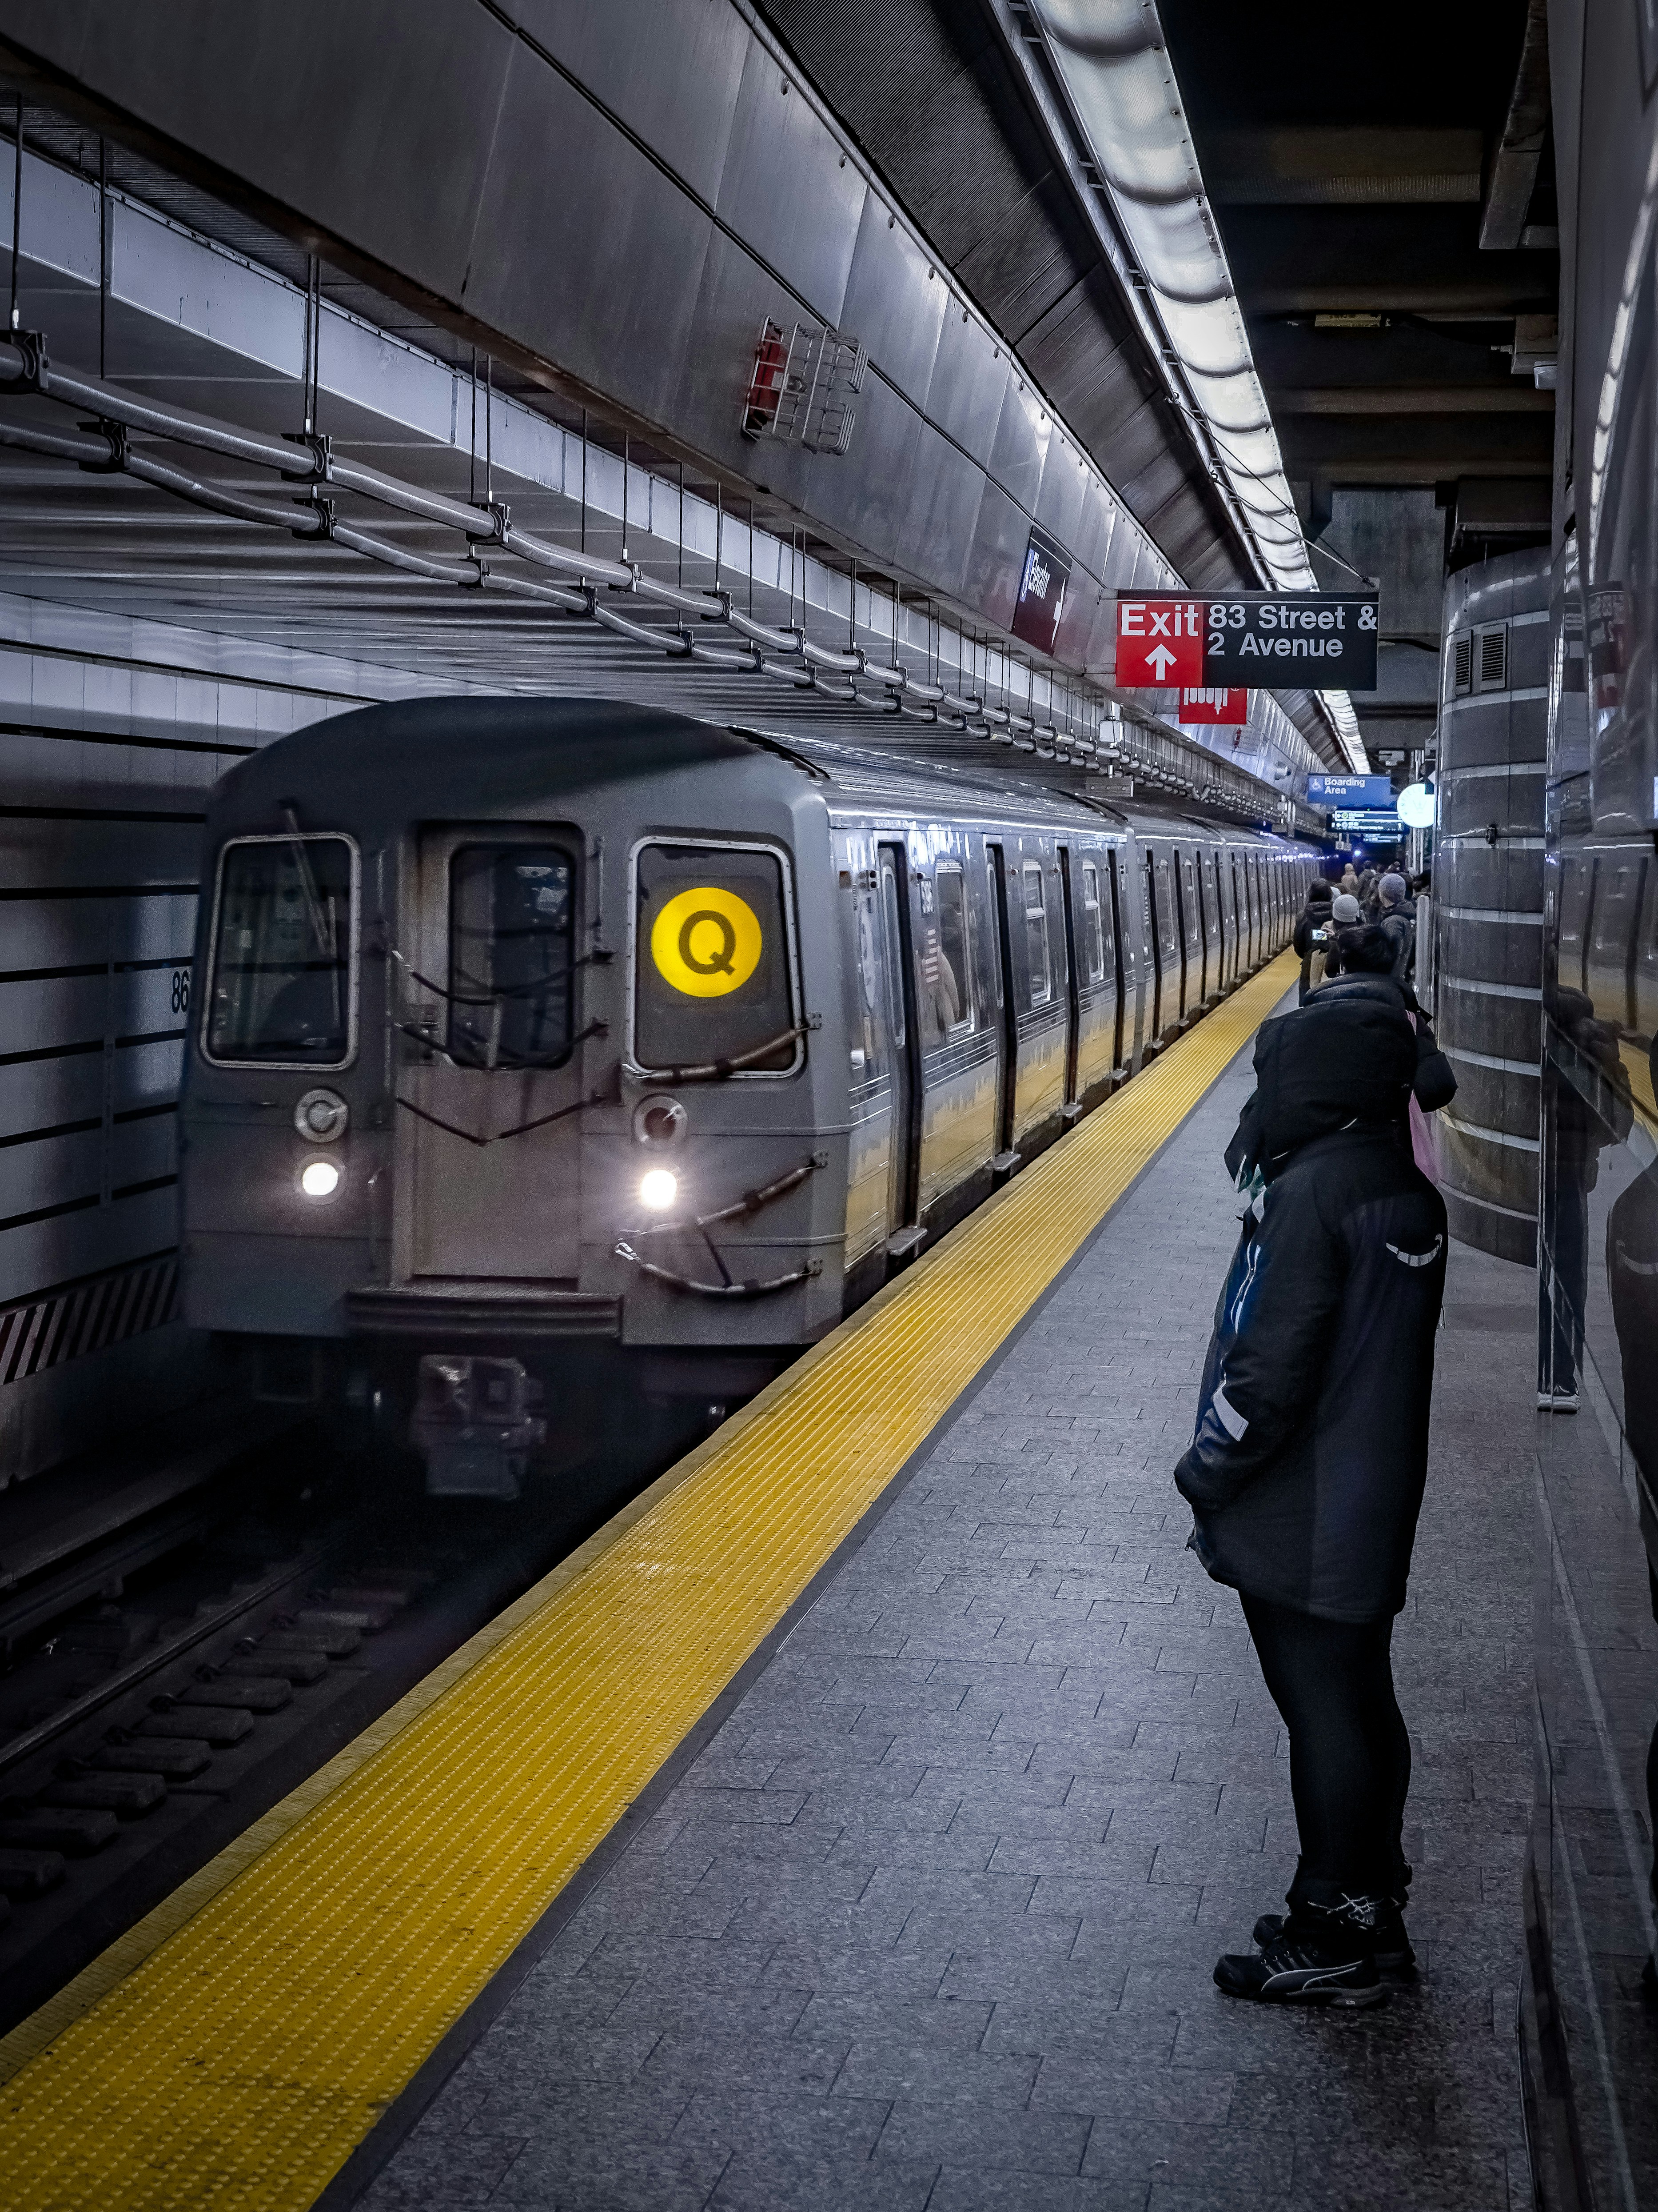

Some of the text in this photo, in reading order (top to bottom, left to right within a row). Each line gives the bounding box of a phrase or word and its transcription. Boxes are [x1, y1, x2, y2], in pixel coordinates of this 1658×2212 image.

[1121, 604, 1199, 636] Exit
[1208, 605, 1377, 630] 83 Street &
[1208, 632, 1343, 657] 2 Avenue
[1324, 777, 1365, 788] Boarding
[1324, 786, 1347, 795] Area
[679, 910, 736, 975] Q
[172, 970, 189, 1013] 86
